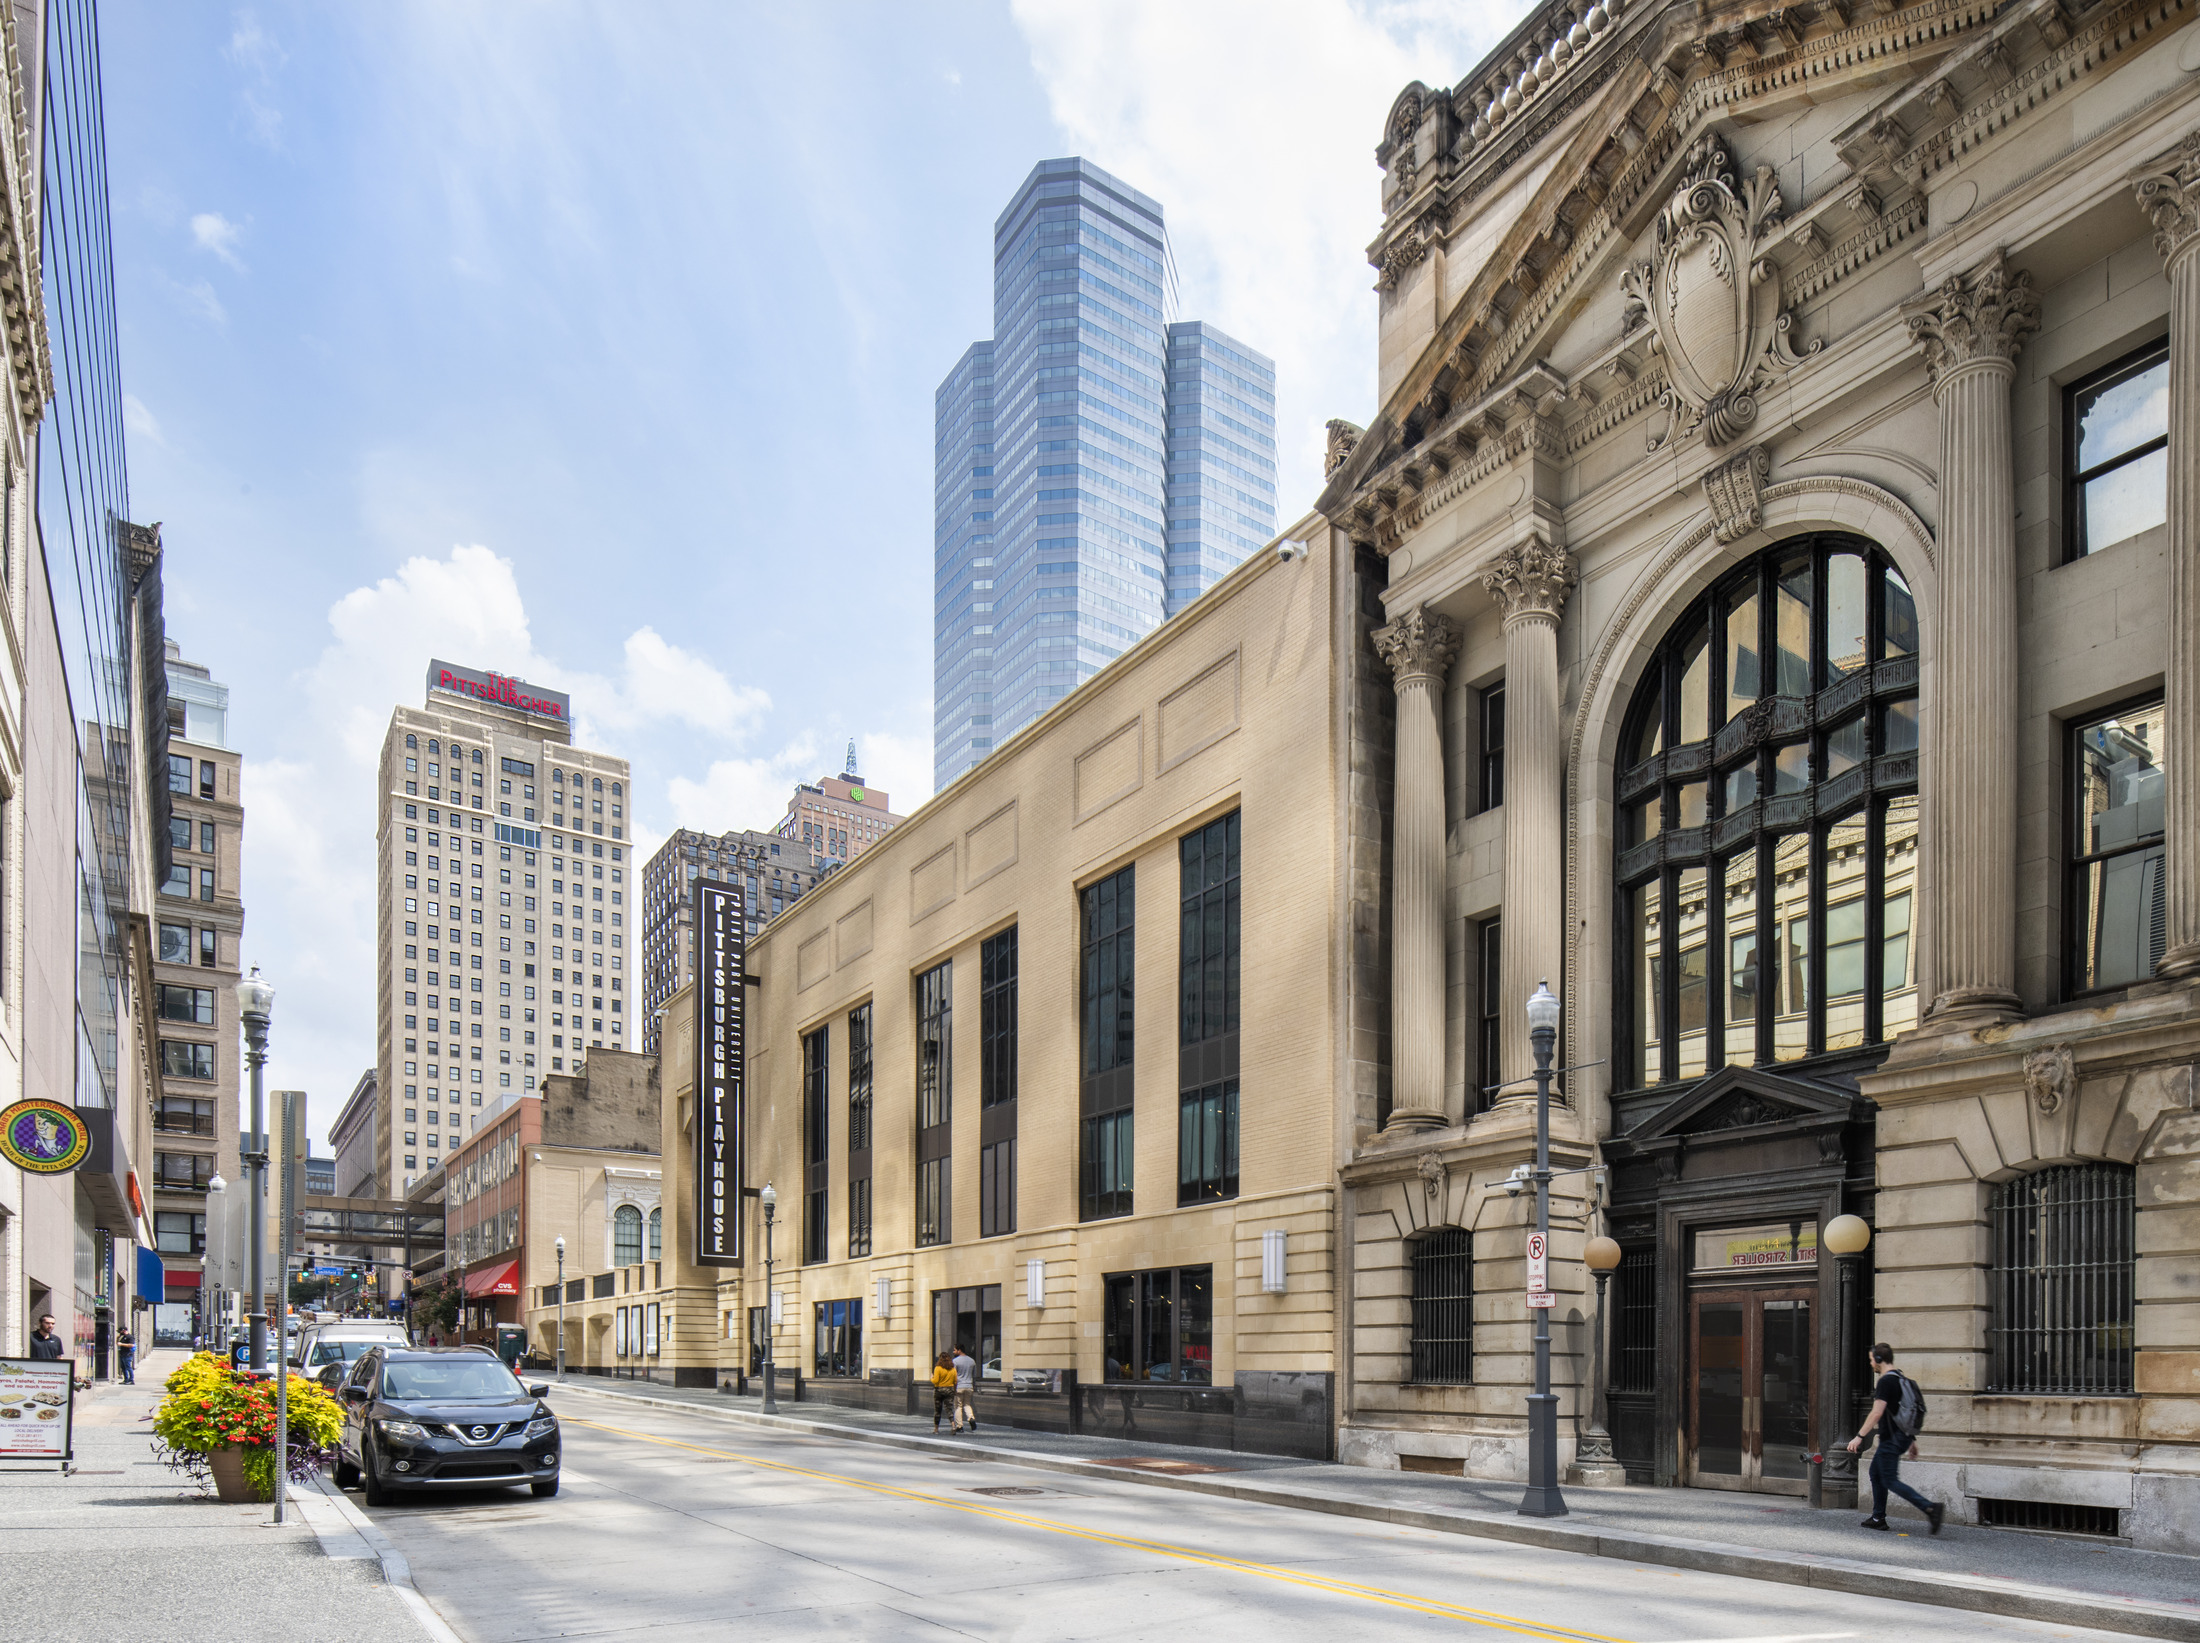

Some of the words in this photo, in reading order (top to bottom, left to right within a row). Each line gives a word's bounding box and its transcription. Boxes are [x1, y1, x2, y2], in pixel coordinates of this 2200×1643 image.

[440, 669, 562, 717] PITTSBURGHER
[487, 672, 517, 692] THE
[731, 901, 741, 943] POINT
[714, 894, 725, 1079] PITTSBURGH
[731, 953, 741, 986] PARK
[731, 996, 740, 1080] UNIVERSITY
[10, 1101, 78, 1122] MEDITERRANEAN
[76, 1122, 87, 1141] GRILL
[1, 1140, 17, 1157] HOME
[25, 1161, 41, 1169] THE
[60, 1144, 85, 1168] STROLLER
[713, 1086, 725, 1252] PLAYHOUSE
